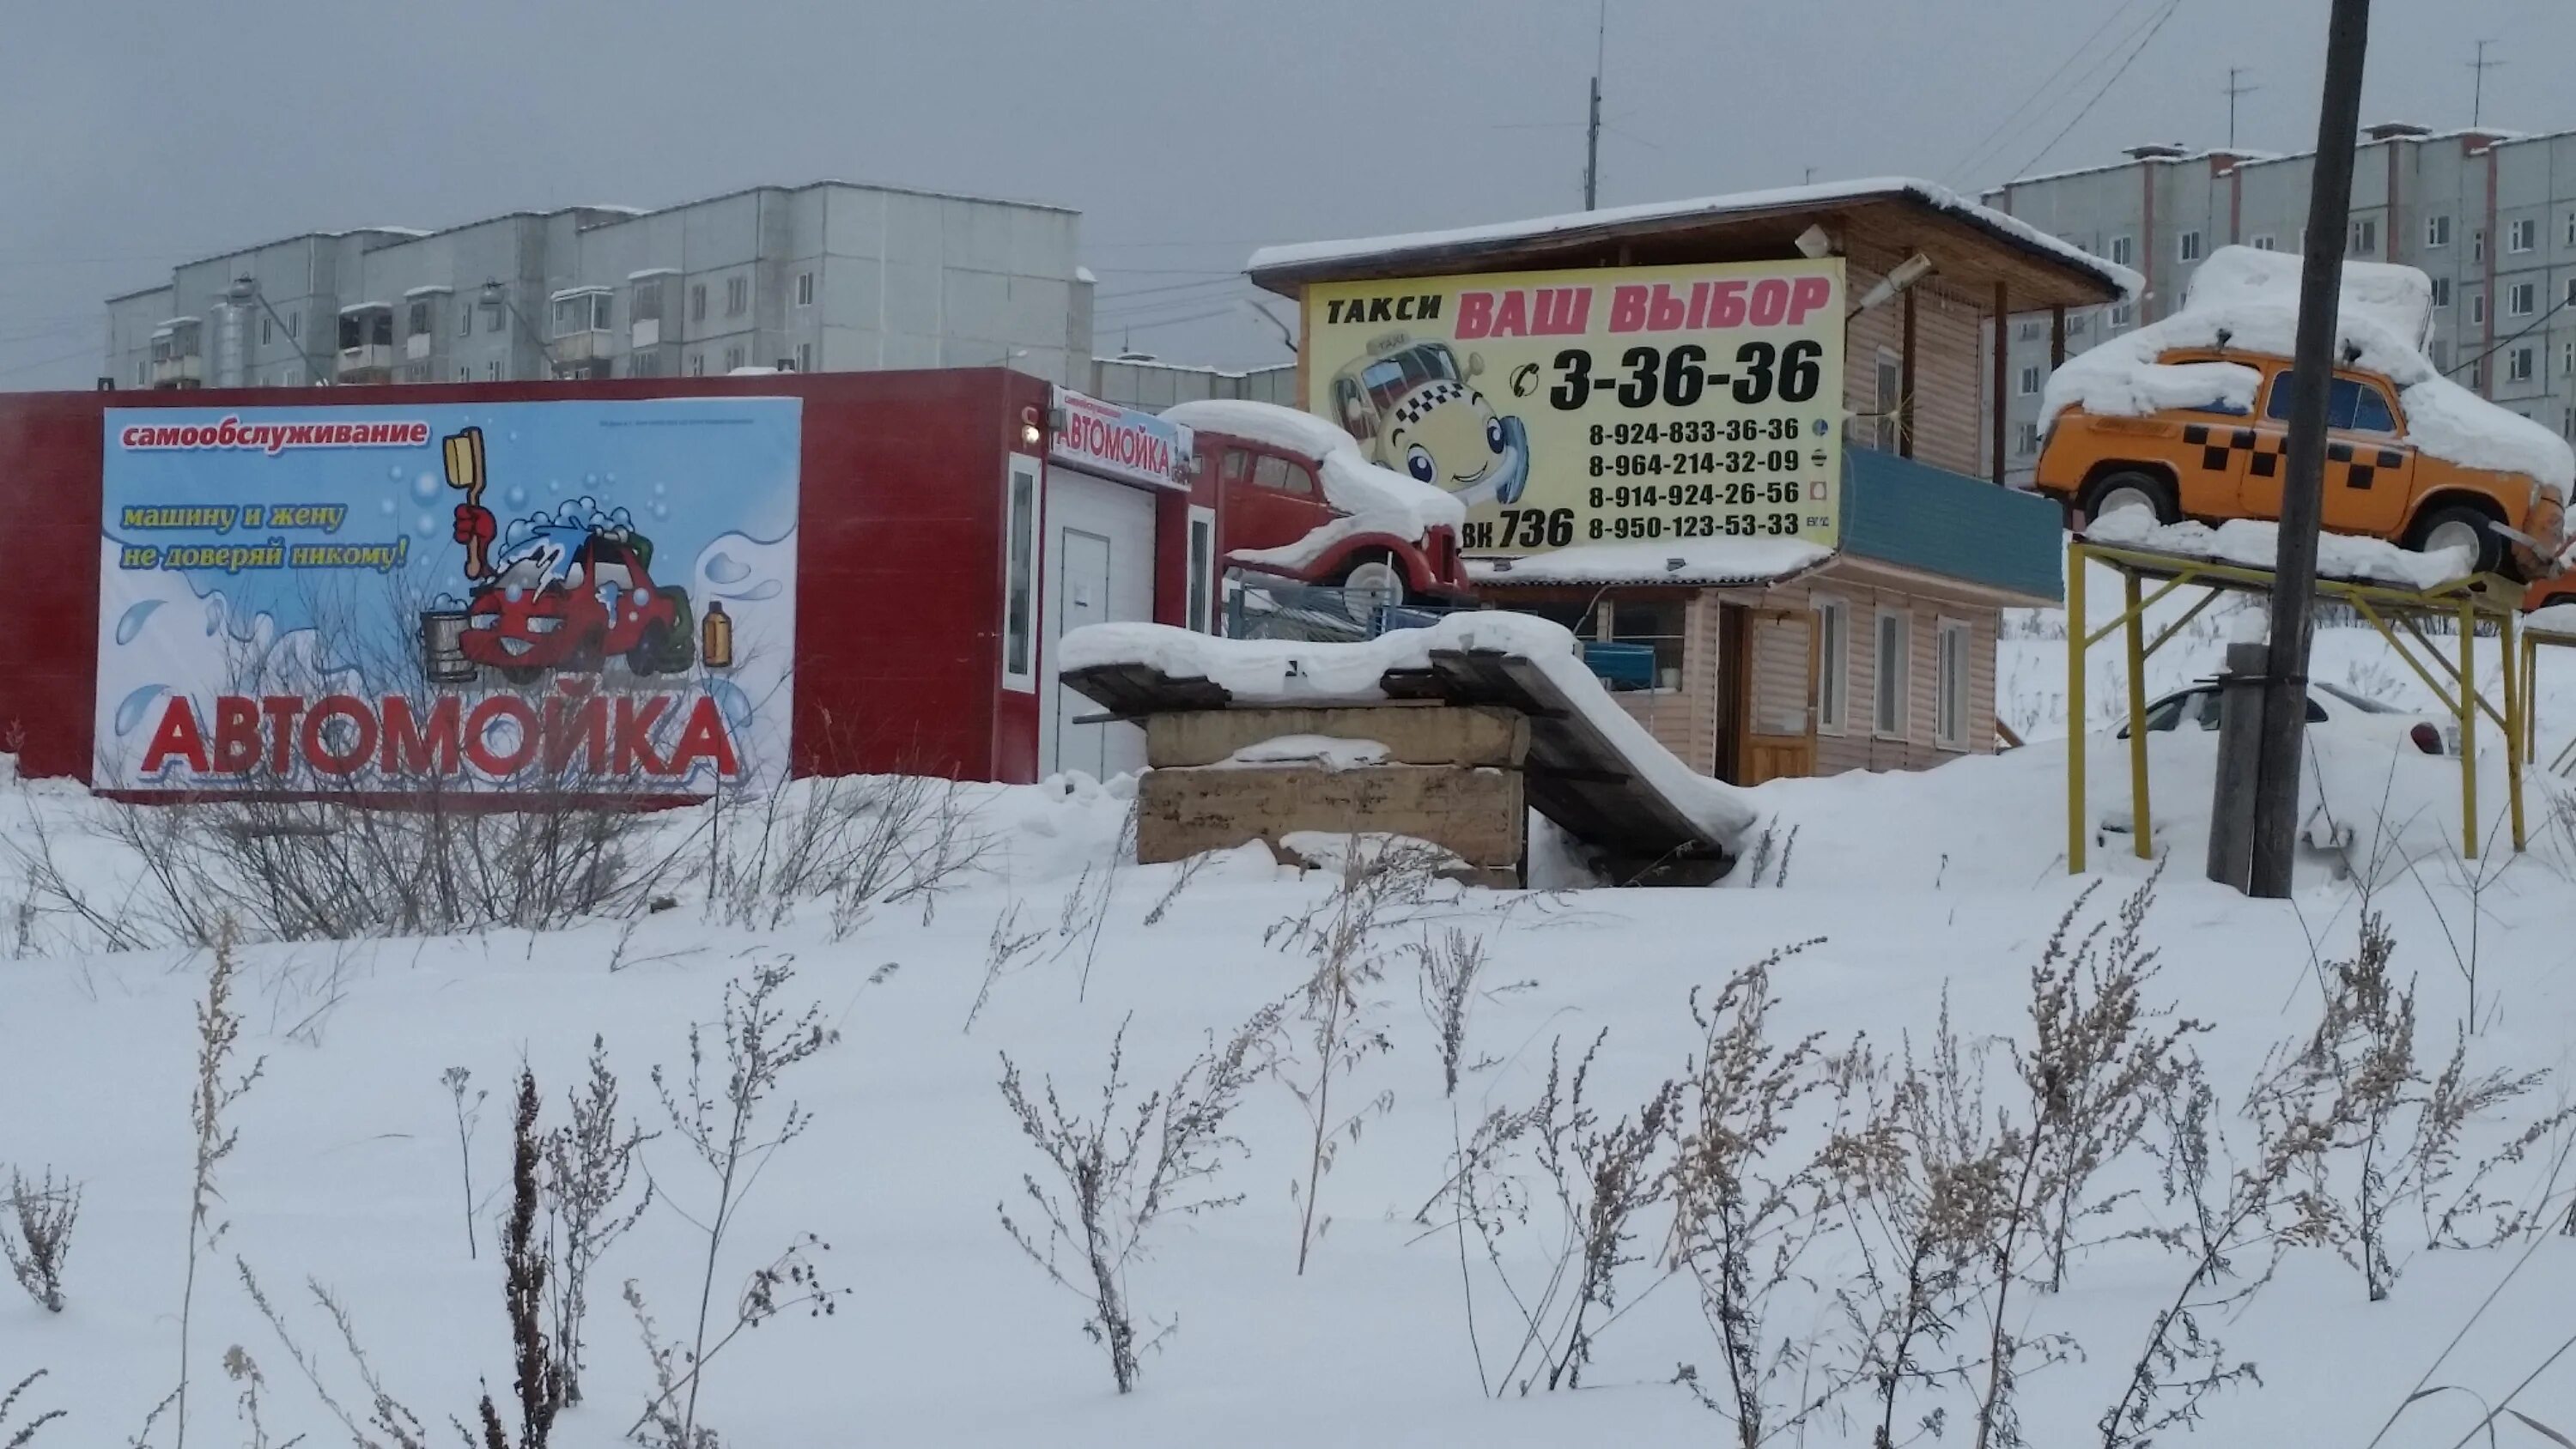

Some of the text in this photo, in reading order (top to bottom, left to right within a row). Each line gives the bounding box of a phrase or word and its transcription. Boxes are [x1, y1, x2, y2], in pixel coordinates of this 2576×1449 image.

[1327, 276, 1832, 339] ТАКСИ ВАШ ВЫБОР
[1550, 339, 1823, 410] 3-36-36
[122, 417, 428, 452] самообслуживание
[1589, 418, 1799, 446] 8-924-833-36-36
[1589, 450, 1799, 476] 8-964-214-32-09
[1589, 482, 1800, 508] 8-914-924-26-56
[124, 506, 346, 532] машину и жену
[1499, 508, 1575, 548] 736
[1589, 513, 1799, 539] 8-950-123-53-33
[123, 537, 409, 572] не доверяй никому!
[141, 677, 738, 777] АВТОМОЙКА
